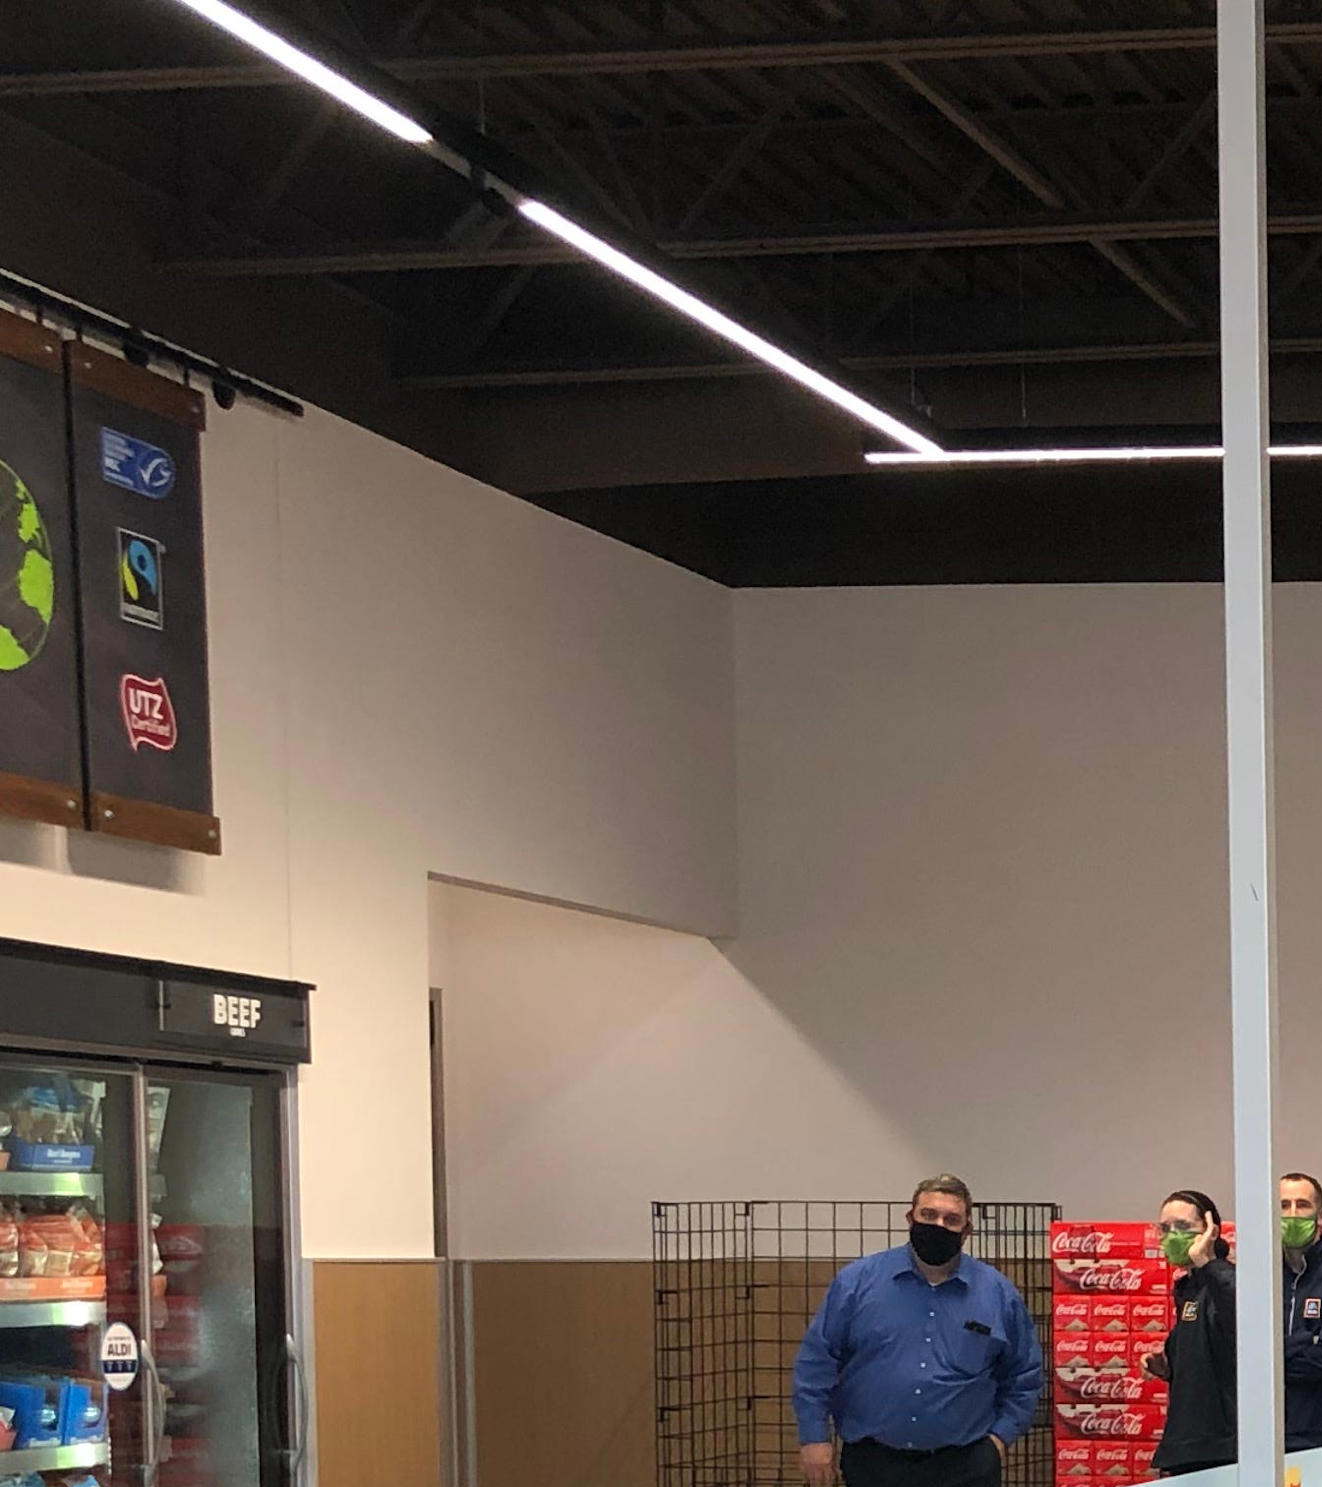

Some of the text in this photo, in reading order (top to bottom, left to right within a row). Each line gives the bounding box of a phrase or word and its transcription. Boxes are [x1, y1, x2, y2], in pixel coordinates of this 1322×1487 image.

[129, 688, 164, 720] UTZ
[213, 994, 261, 1029] BEEF
[108, 1343, 131, 1357] ALDI
